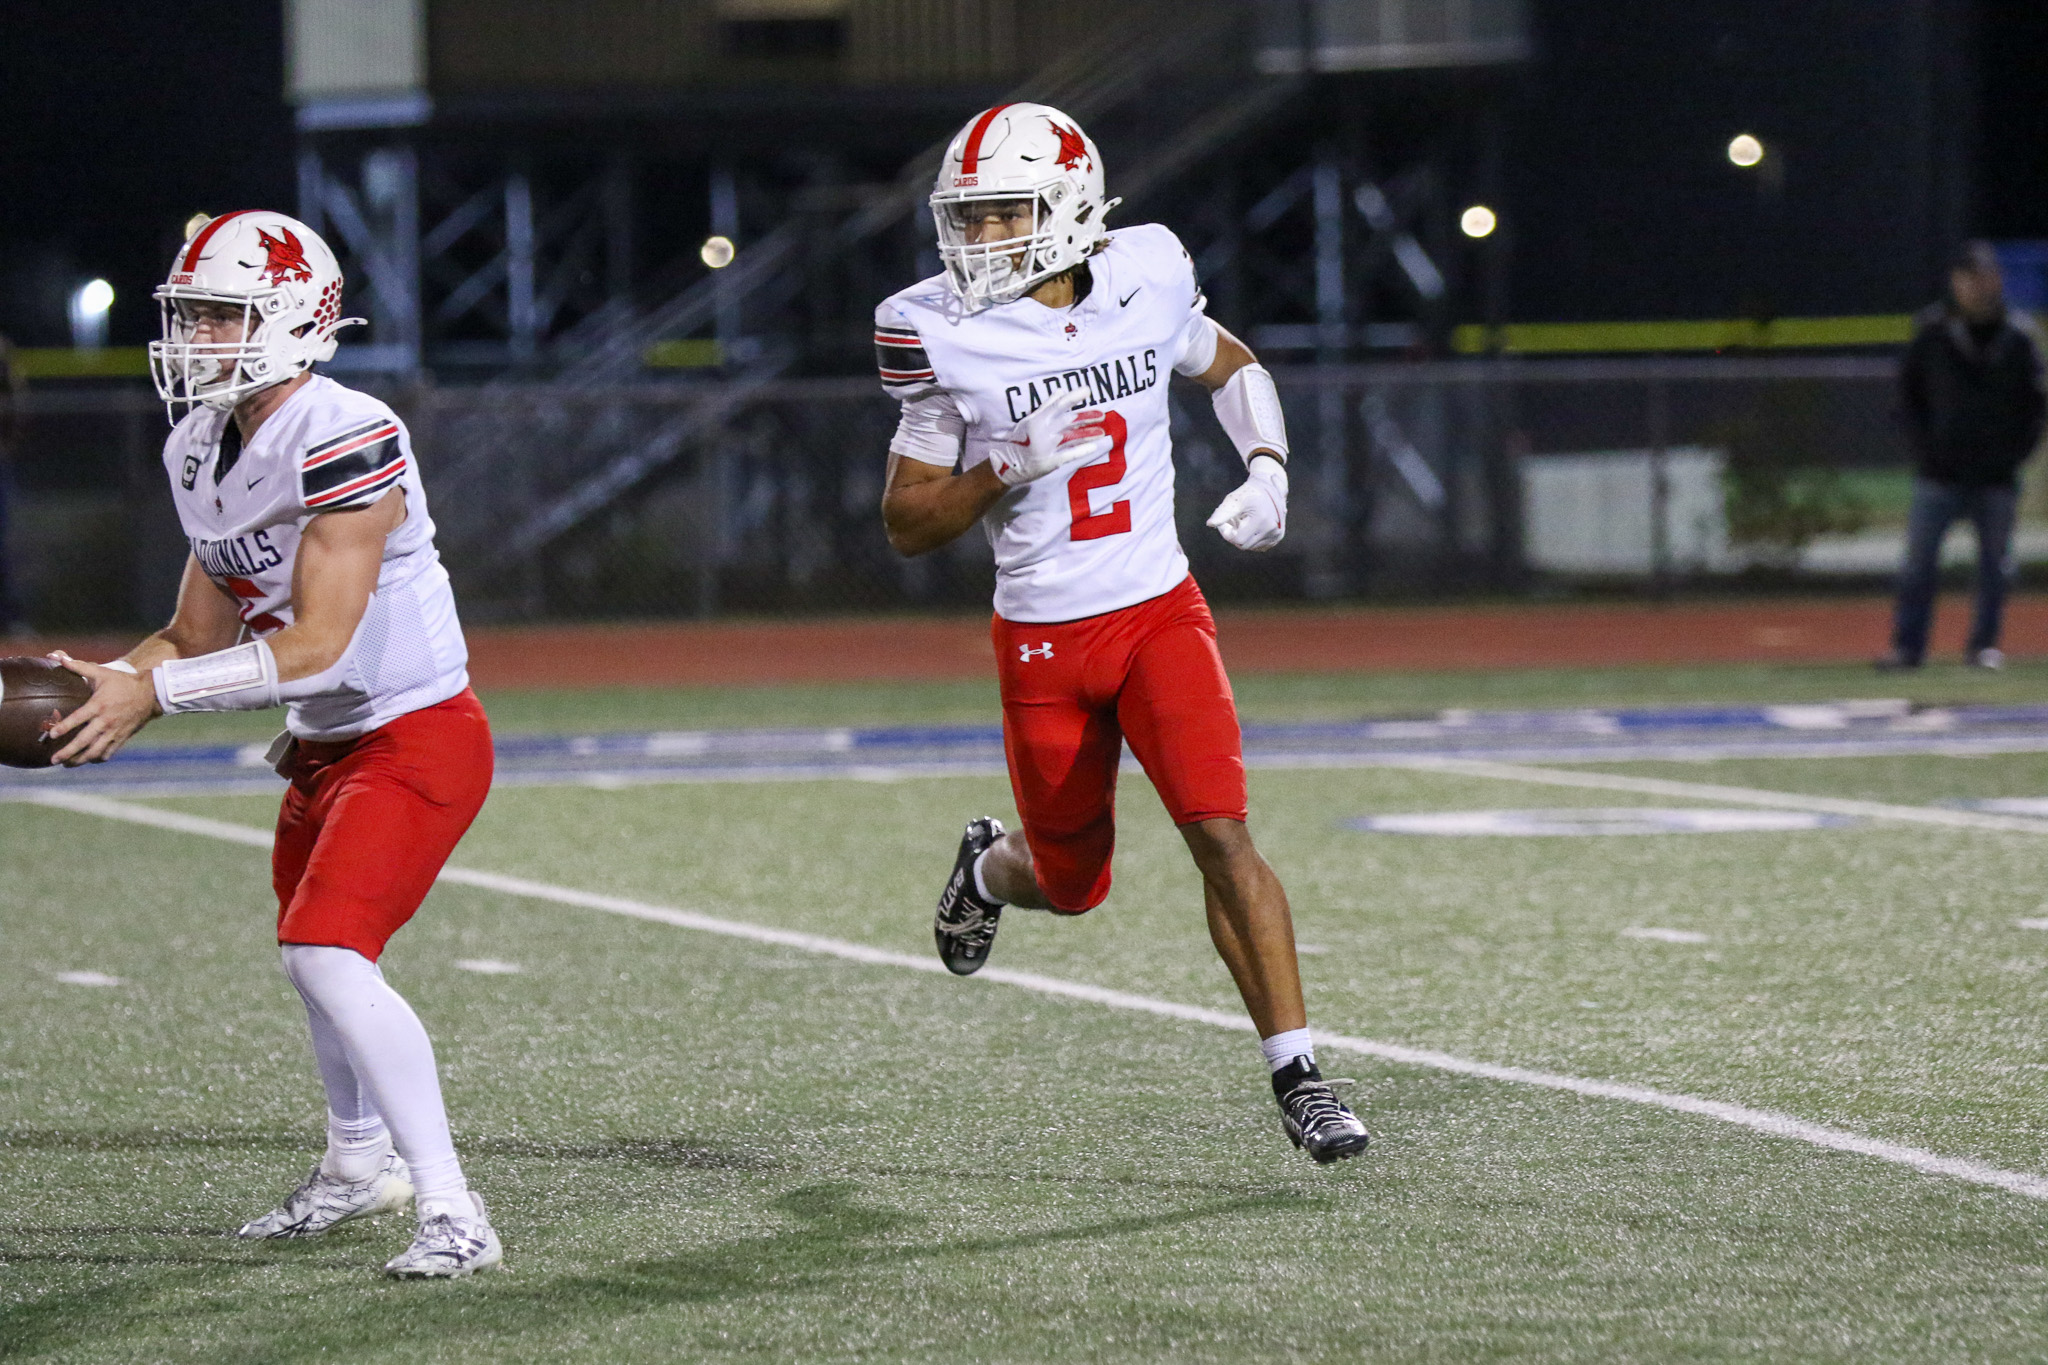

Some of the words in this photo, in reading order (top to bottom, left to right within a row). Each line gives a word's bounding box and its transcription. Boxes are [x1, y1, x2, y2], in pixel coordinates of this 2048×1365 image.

[953, 176, 979, 188] CARDS
[171, 274, 194, 285] CARDS
[1067, 410, 1132, 542] 2
